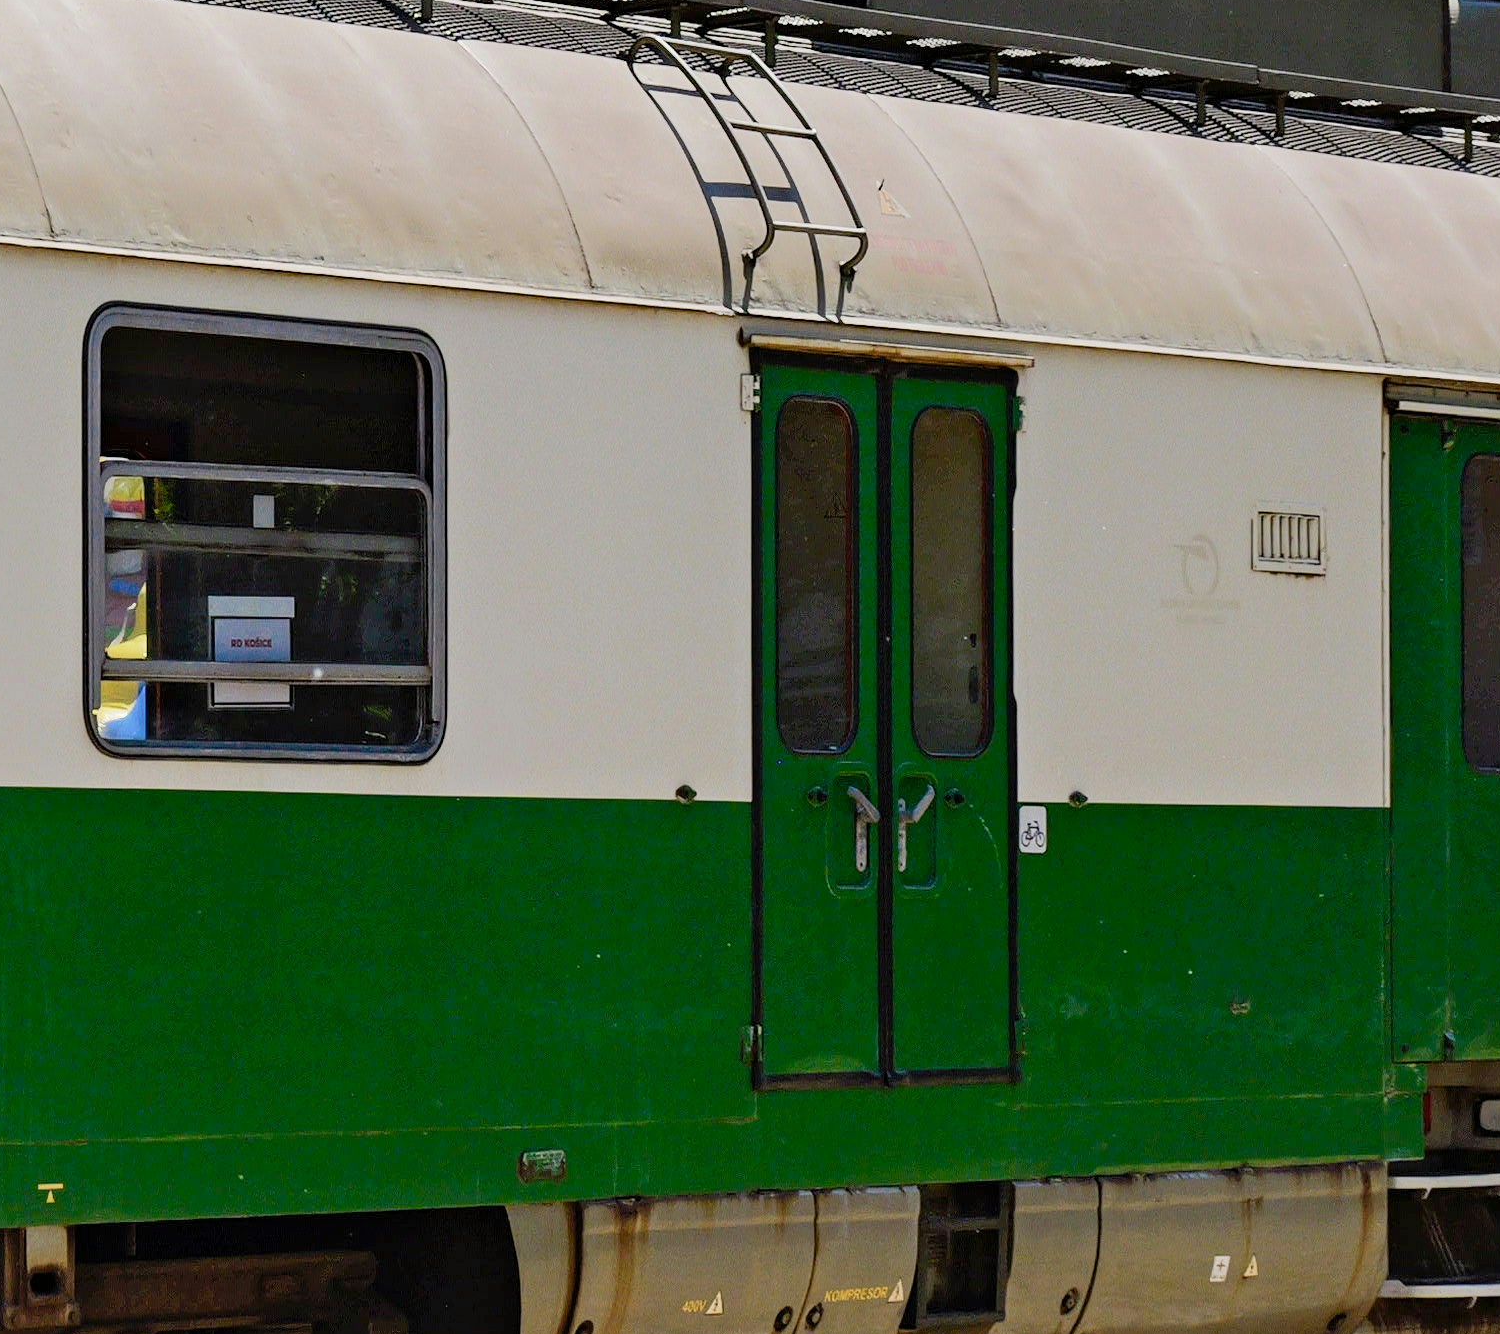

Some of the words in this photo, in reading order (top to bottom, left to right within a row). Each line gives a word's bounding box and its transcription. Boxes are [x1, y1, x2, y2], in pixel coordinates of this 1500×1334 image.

[230, 638, 242, 648] RD
[824, 1286, 889, 1302] KOMPRESOR
[682, 1299, 706, 1312] 400V
